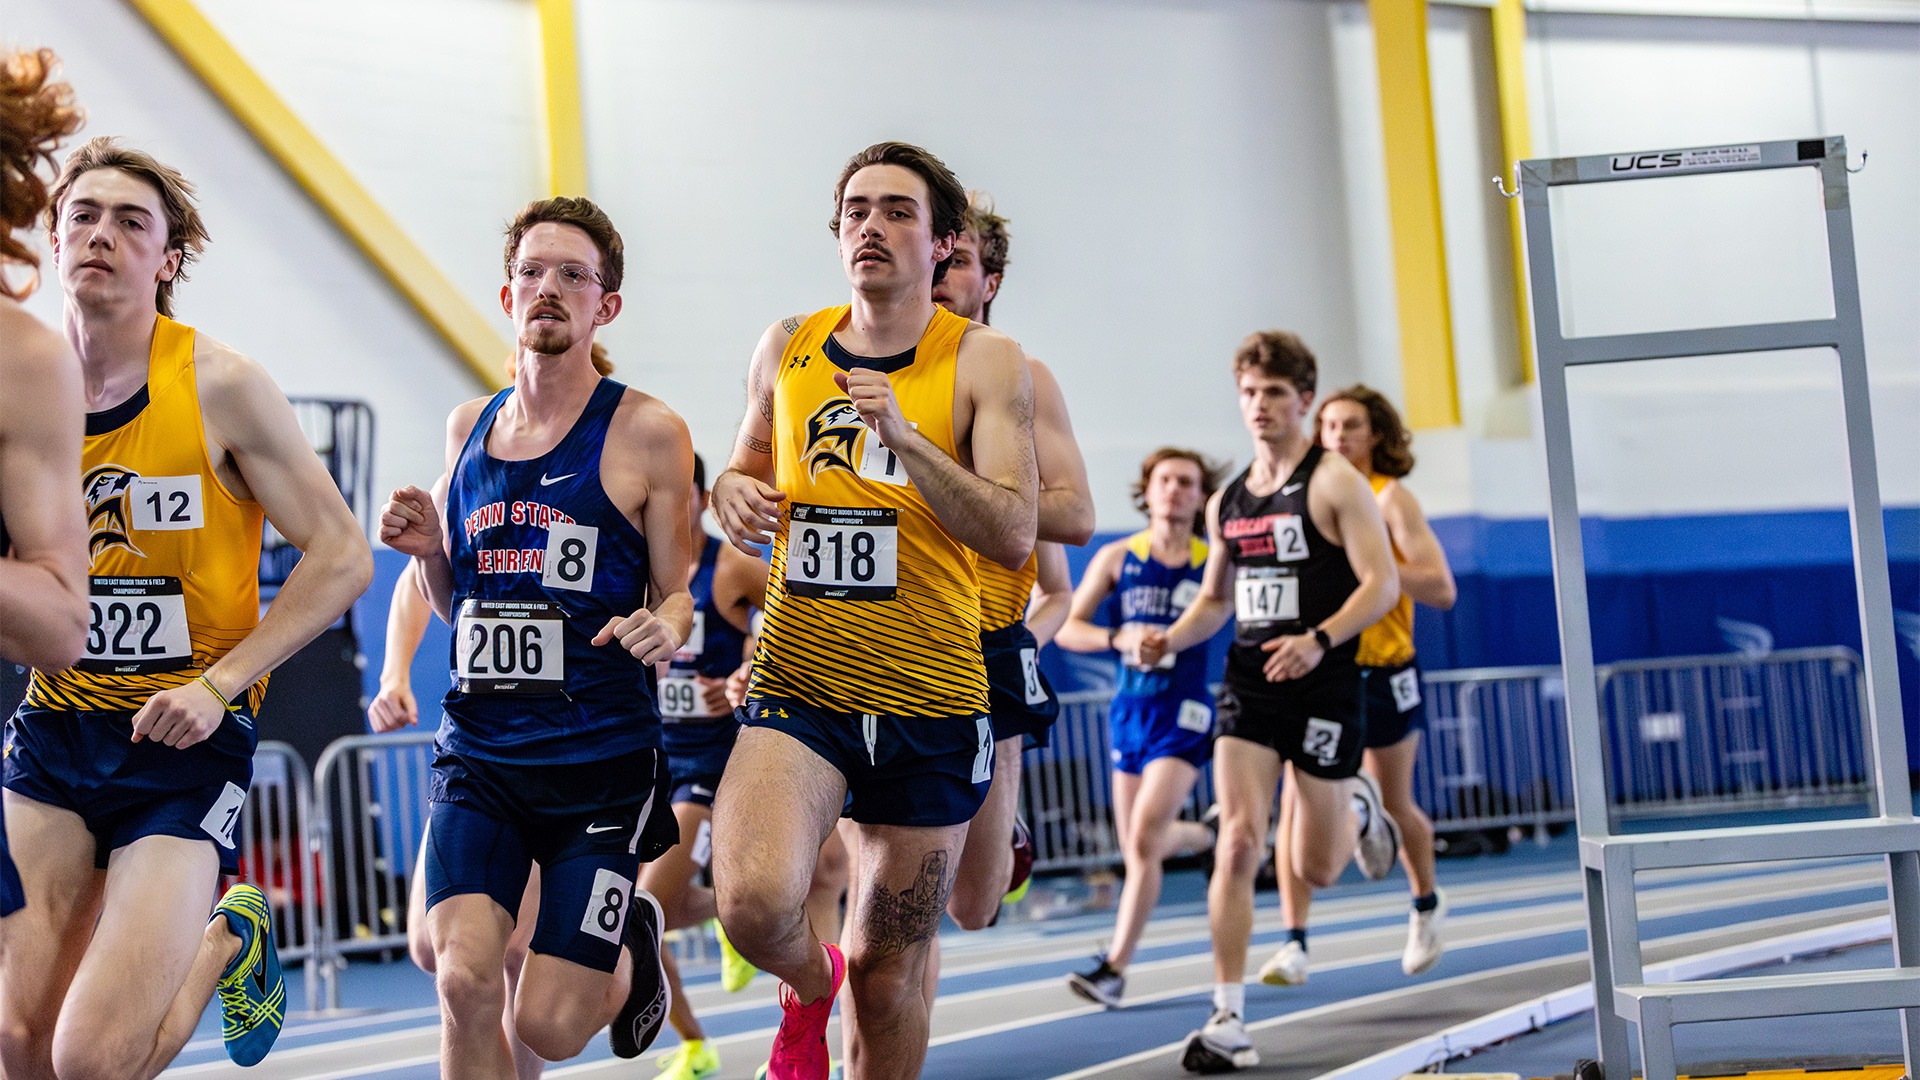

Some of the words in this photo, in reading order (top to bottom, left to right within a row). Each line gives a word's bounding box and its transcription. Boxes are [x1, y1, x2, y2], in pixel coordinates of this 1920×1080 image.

[1613, 153, 1682, 171] UCS
[146, 491, 191, 523] 12
[464, 501, 505, 545] PENN
[511, 501, 577, 531] STAT
[802, 528, 875, 582] 318
[1283, 527, 1303, 554] 2
[477, 549, 546, 574] BEHREN
[557, 538, 587, 582] 8
[1246, 583, 1284, 614] 147
[86, 602, 167, 655] 322
[468, 623, 543, 675] 206
[665, 683, 695, 713] 99
[1312, 730, 1333, 756] 2
[597, 887, 624, 933] 8
